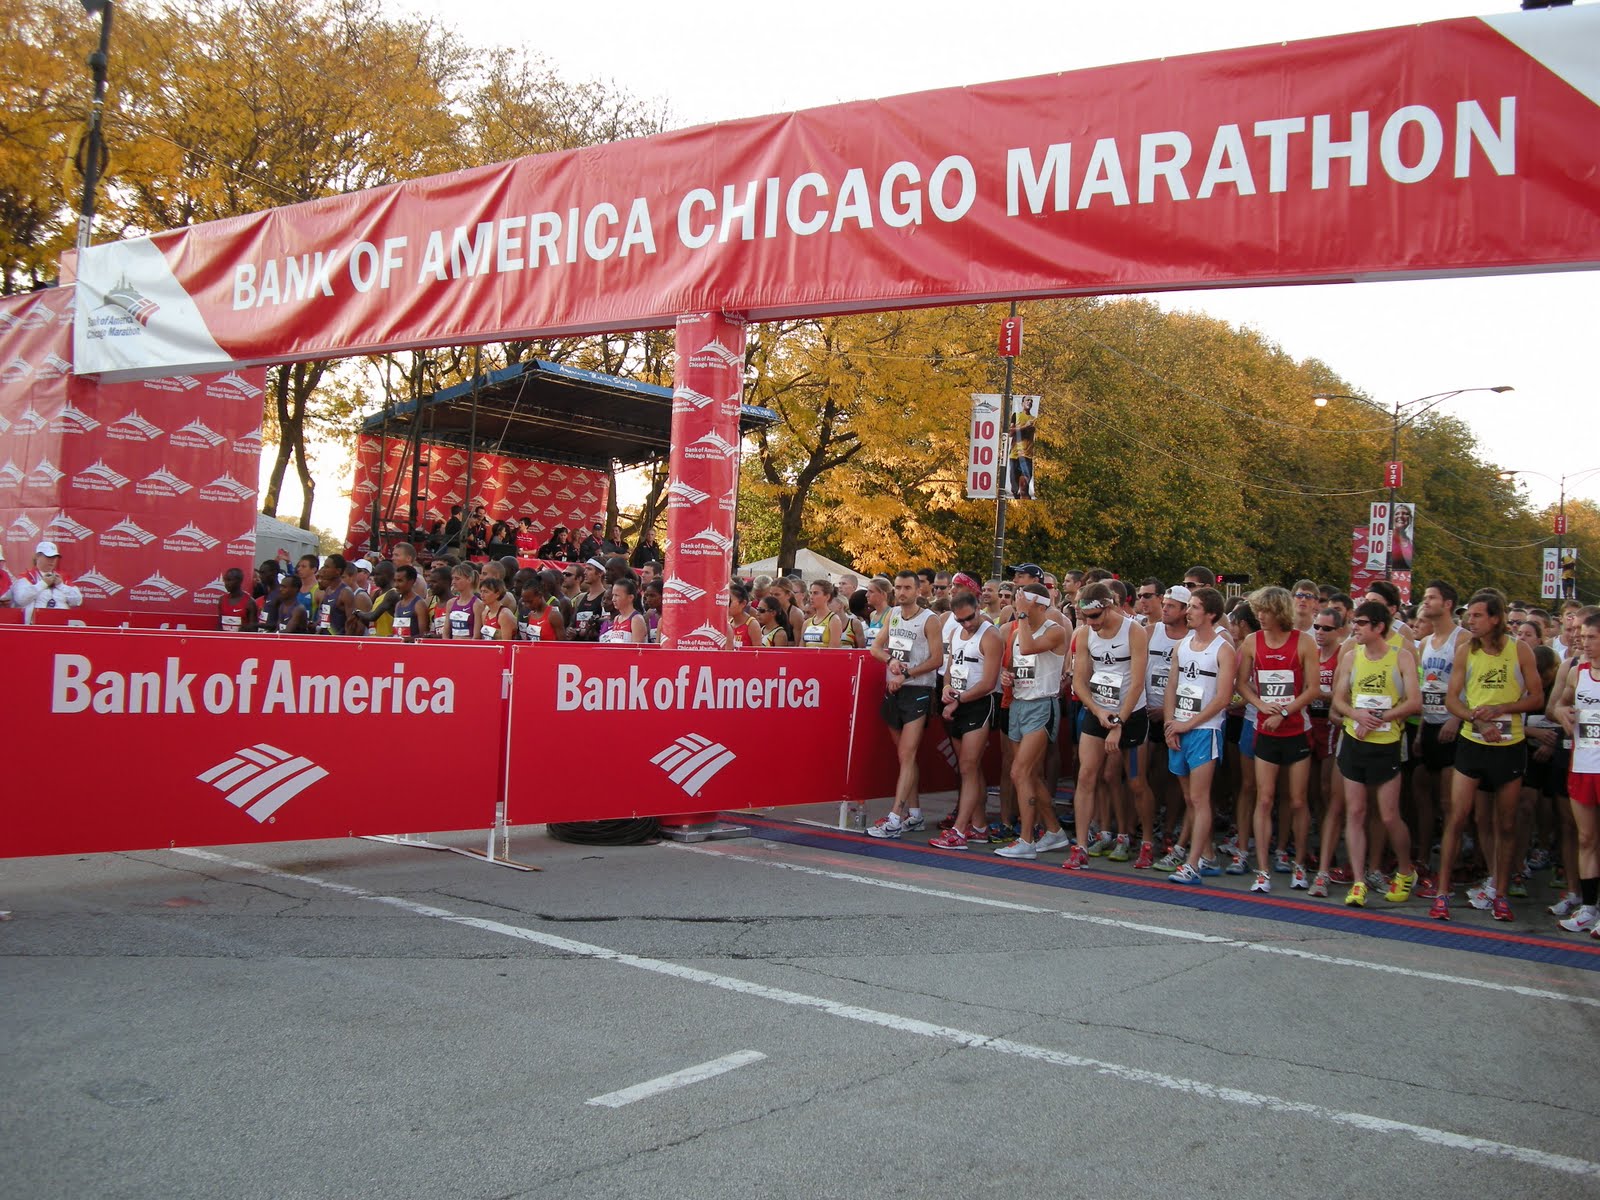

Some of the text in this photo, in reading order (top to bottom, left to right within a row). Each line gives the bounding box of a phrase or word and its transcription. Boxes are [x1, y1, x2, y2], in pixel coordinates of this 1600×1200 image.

[232, 96, 1516, 310] BANK OF AMERICA CHICAGO MARATHON
[975, 421, 994, 439] 10
[973, 446, 993, 465] 10
[972, 472, 991, 490] 10
[1374, 505, 1386, 518] 10
[1372, 523, 1385, 536] 10
[1372, 541, 1384, 553] 10
[1546, 561, 1555, 570] 10
[1545, 573, 1554, 582] 10
[1544, 586, 1554, 594] 10
[51, 654, 455, 714] Bank of America
[556, 664, 820, 712] Bank of America
[1267, 684, 1286, 696] 377
[1179, 697, 1194, 710] 463
[1425, 694, 1441, 704] 375
